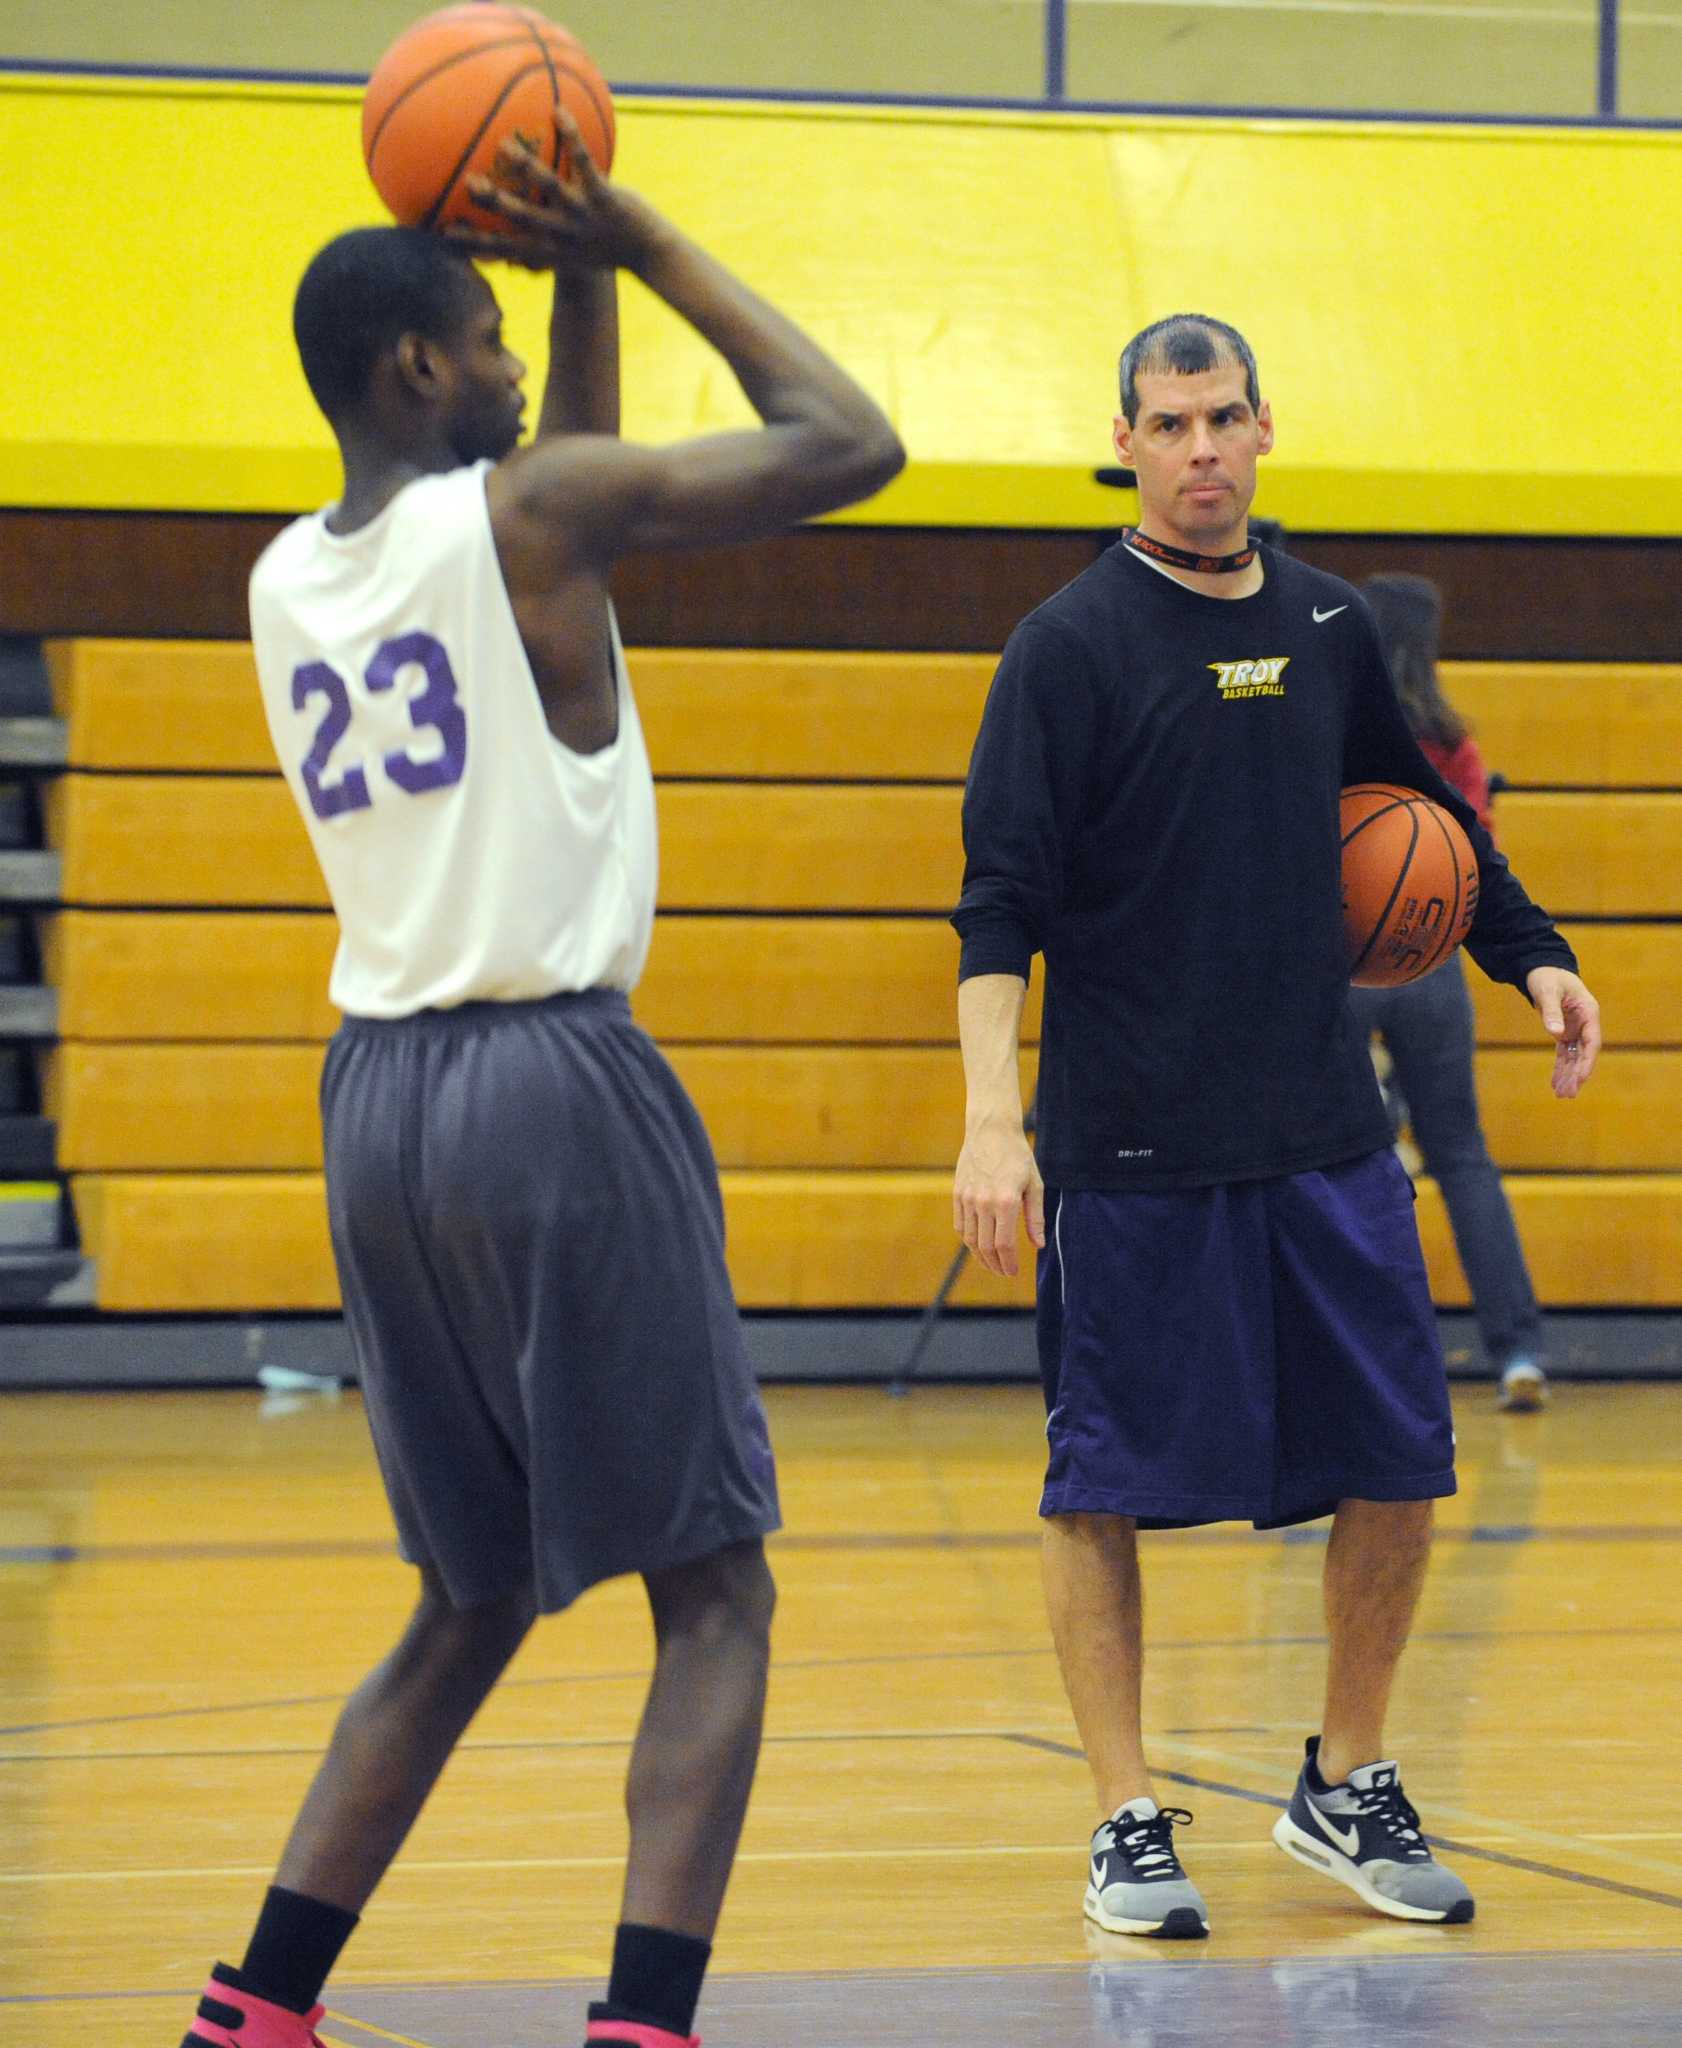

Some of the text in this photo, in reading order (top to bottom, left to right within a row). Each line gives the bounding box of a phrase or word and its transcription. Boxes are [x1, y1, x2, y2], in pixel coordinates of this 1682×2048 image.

[1208, 657, 1291, 688] TROY
[1222, 685, 1285, 699] BASKETBALL
[291, 629, 466, 820] 23
[1118, 1149, 1153, 1158] DRI-FIT
